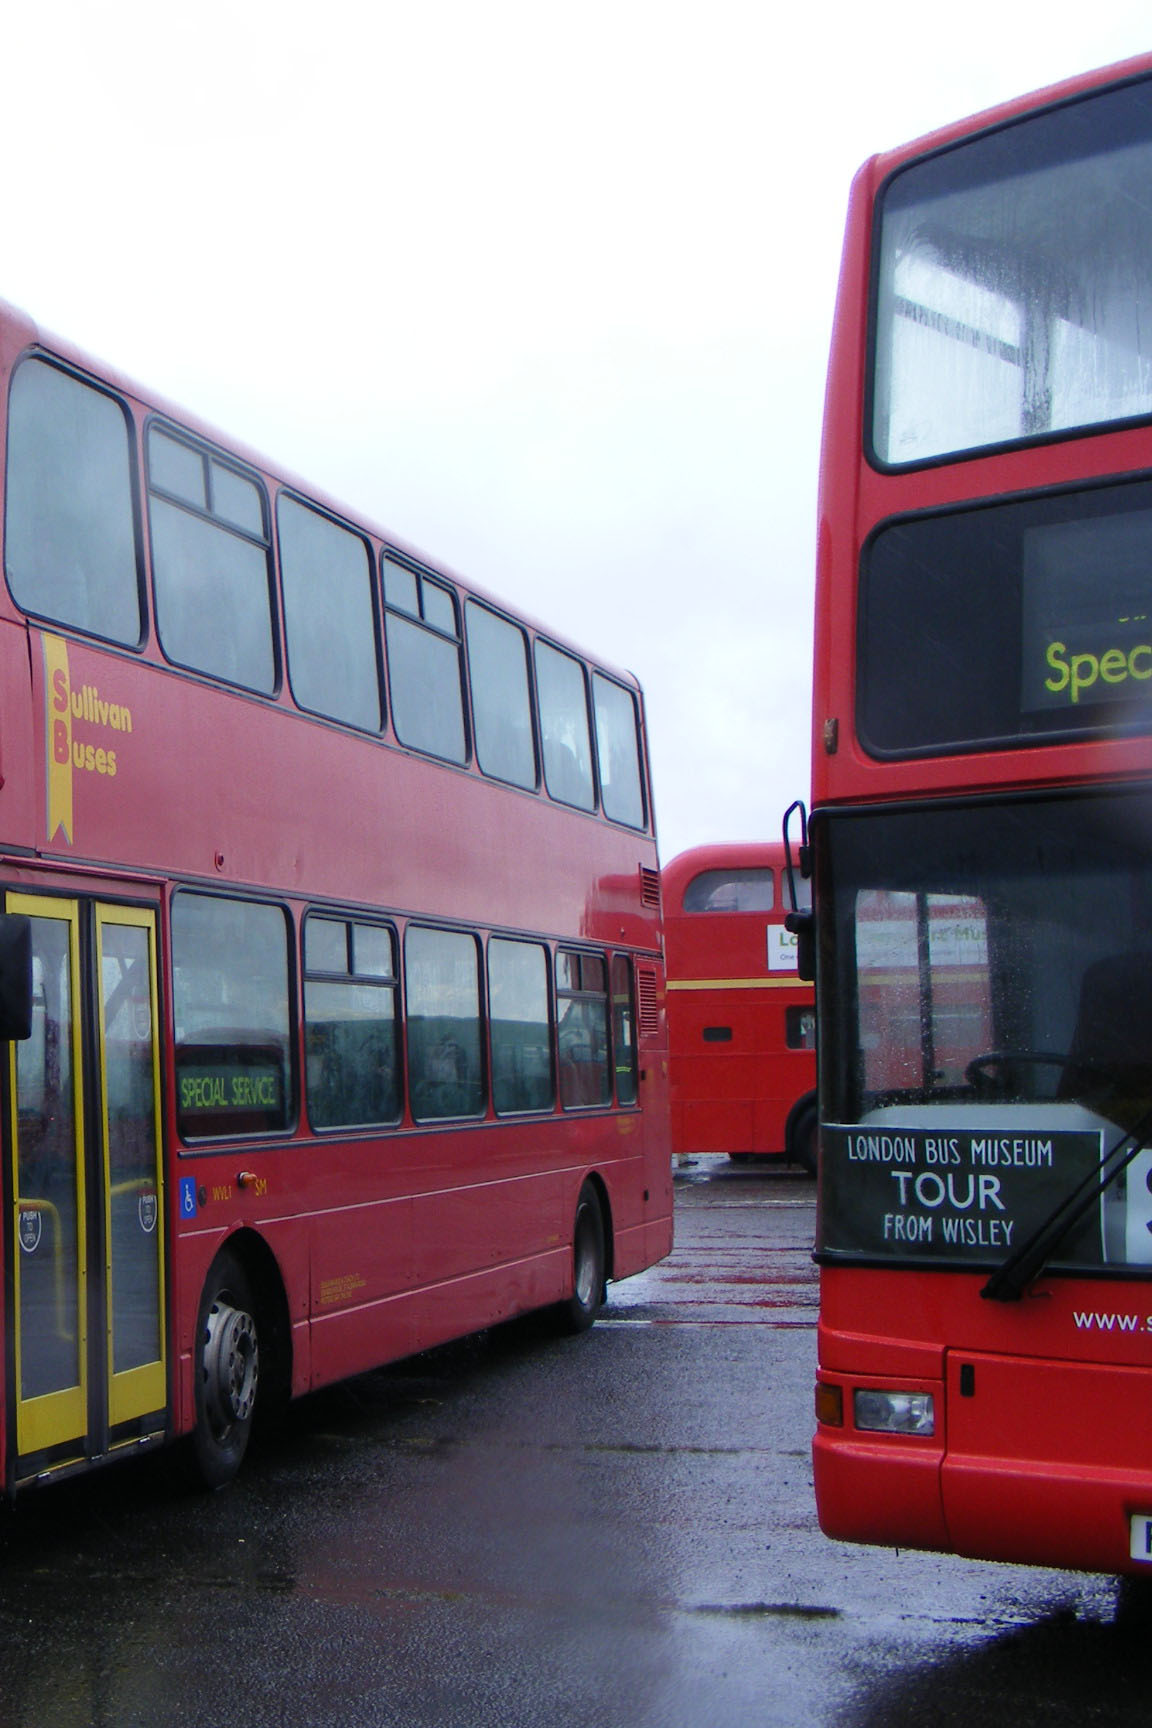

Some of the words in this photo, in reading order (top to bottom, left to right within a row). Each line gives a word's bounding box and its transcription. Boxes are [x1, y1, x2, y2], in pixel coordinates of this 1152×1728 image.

[1045, 641, 1152, 703] Spec
[52, 668, 133, 733] Sullivan
[53, 719, 117, 776] Buses
[181, 1077, 228, 1107] SPECIAL
[232, 1076, 275, 1105] SERVICE
[848, 1135, 915, 1163] LONDON
[925, 1137, 961, 1165] BUS
[971, 1139, 1053, 1167] MUSEUM
[891, 1171, 1006, 1211] TOUR
[883, 1213, 933, 1242] FROM
[942, 1218, 1014, 1246] WISLEY
